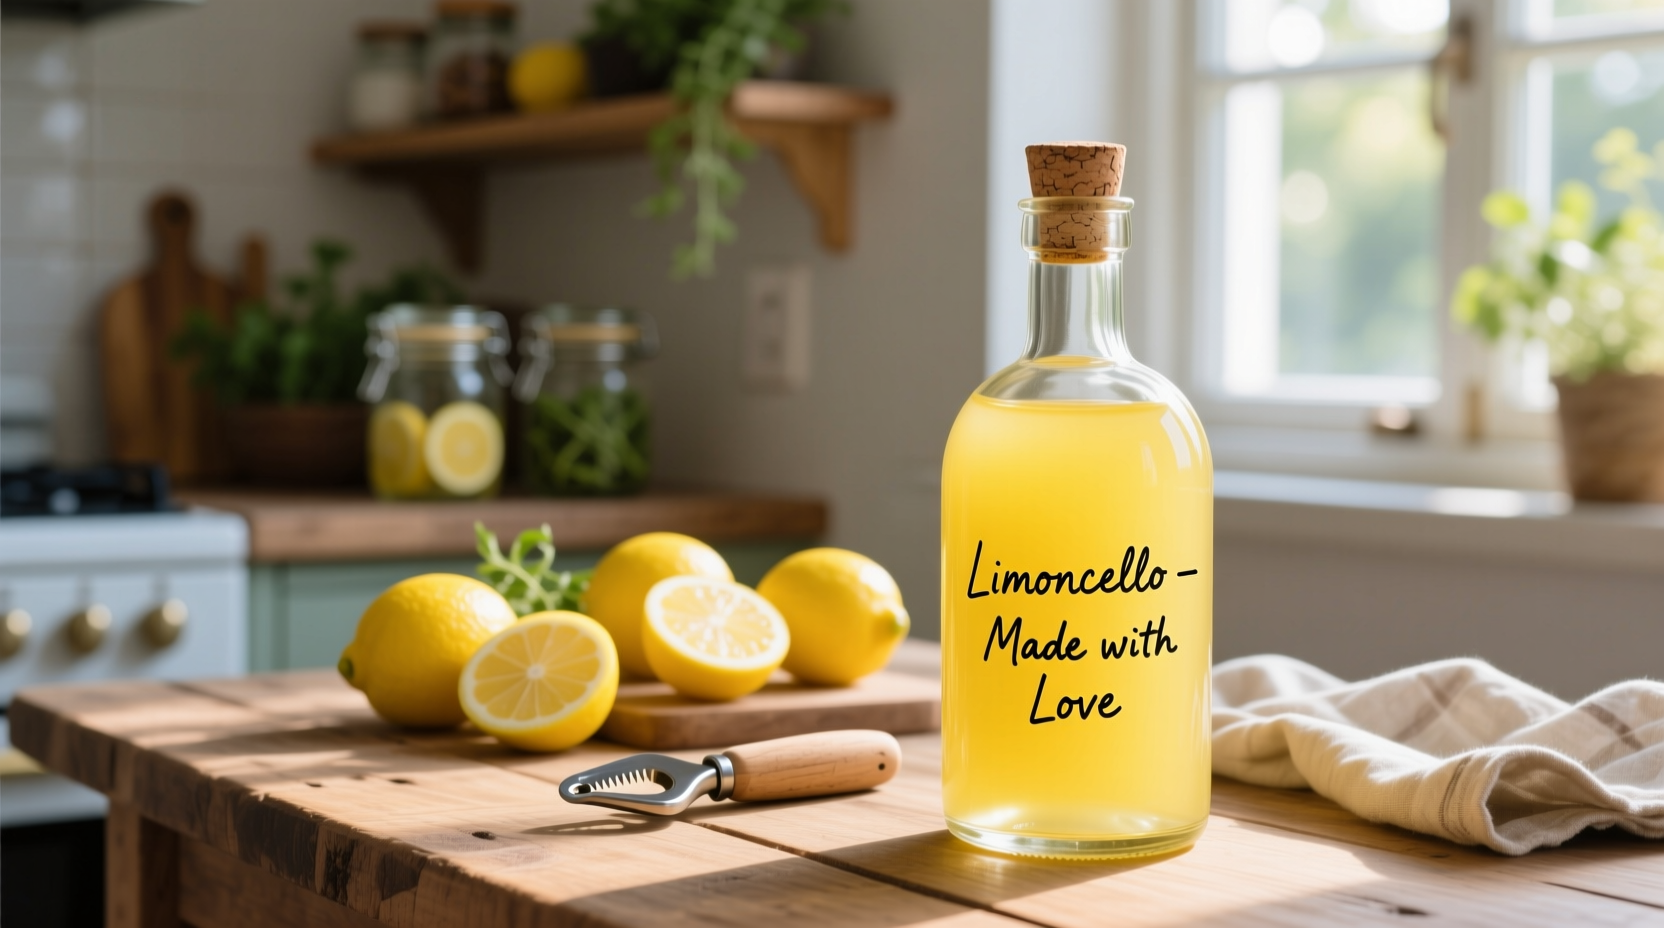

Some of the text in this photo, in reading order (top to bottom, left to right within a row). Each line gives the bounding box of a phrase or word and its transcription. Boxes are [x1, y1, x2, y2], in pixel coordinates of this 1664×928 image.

[967, 540, 1168, 599] Limoncello
[983, 615, 1178, 667] Made with
[1029, 673, 1122, 725] Love
